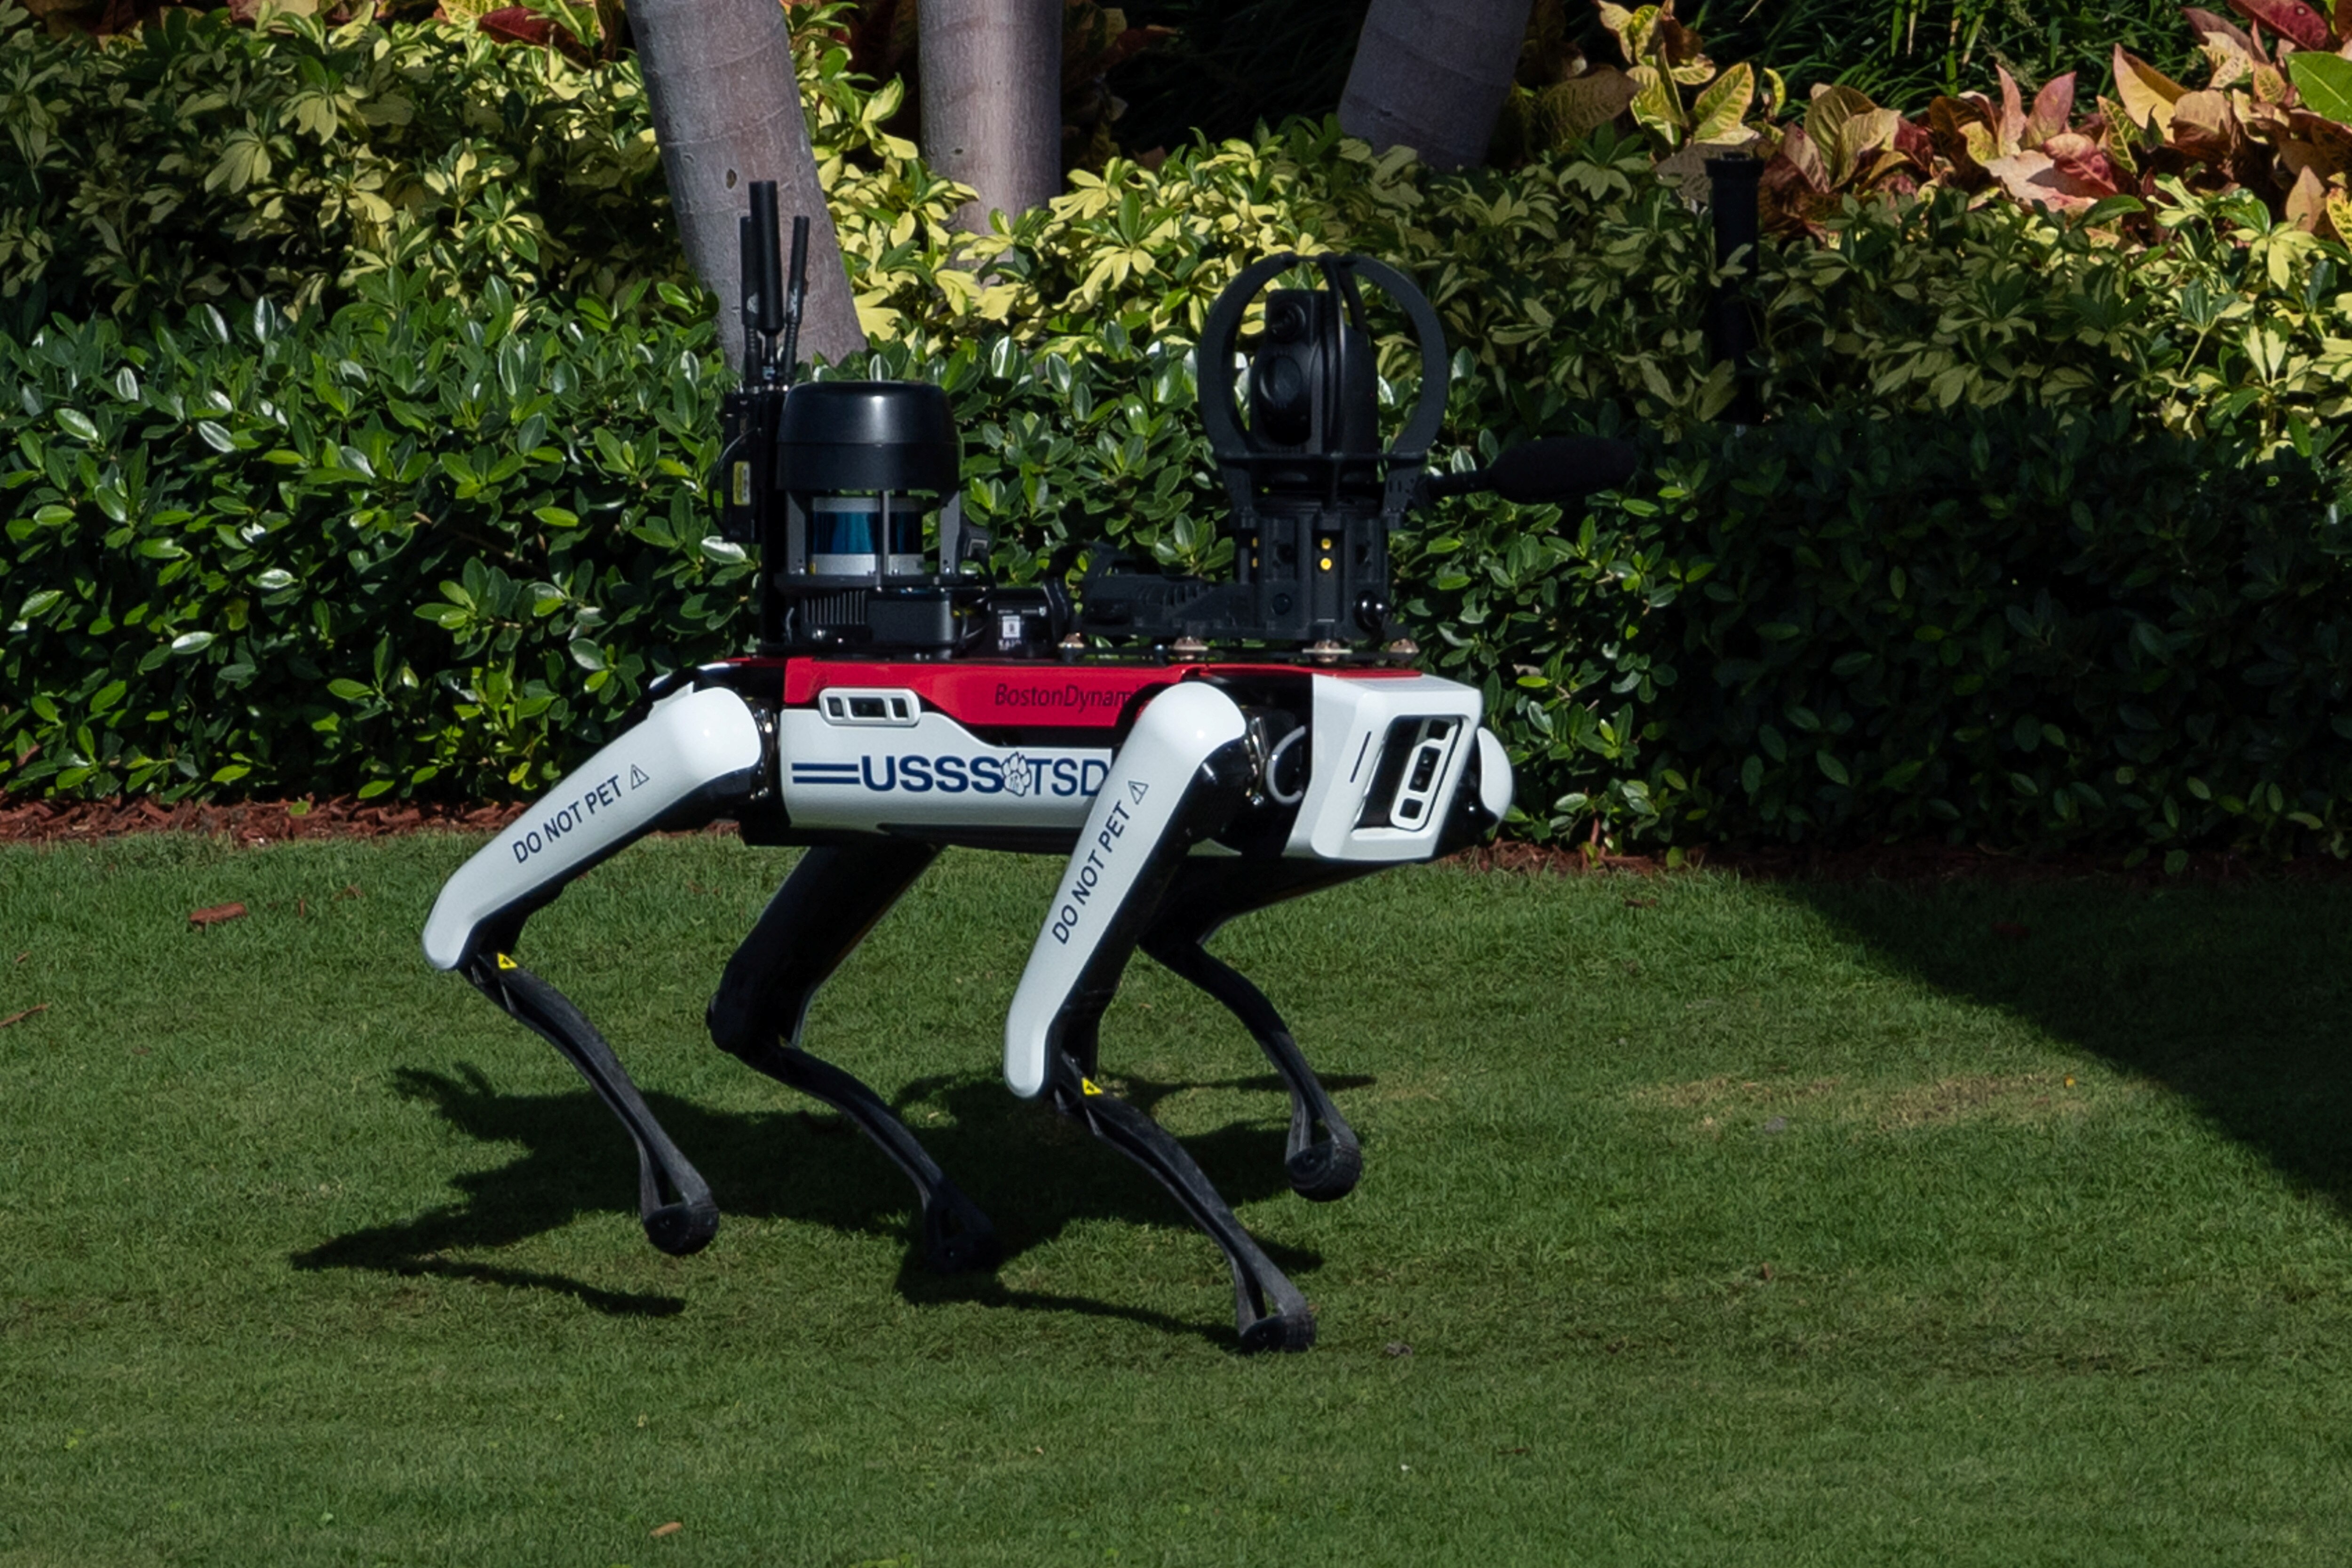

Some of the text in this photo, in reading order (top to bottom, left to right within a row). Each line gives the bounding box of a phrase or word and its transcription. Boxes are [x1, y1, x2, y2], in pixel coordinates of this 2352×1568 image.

[994, 683, 1139, 713] BostonDynam
[861, 755, 1109, 797] USSS TSD
[512, 774, 622, 864] DO NOT PET
[1051, 800, 1130, 945] DO NOT PET
